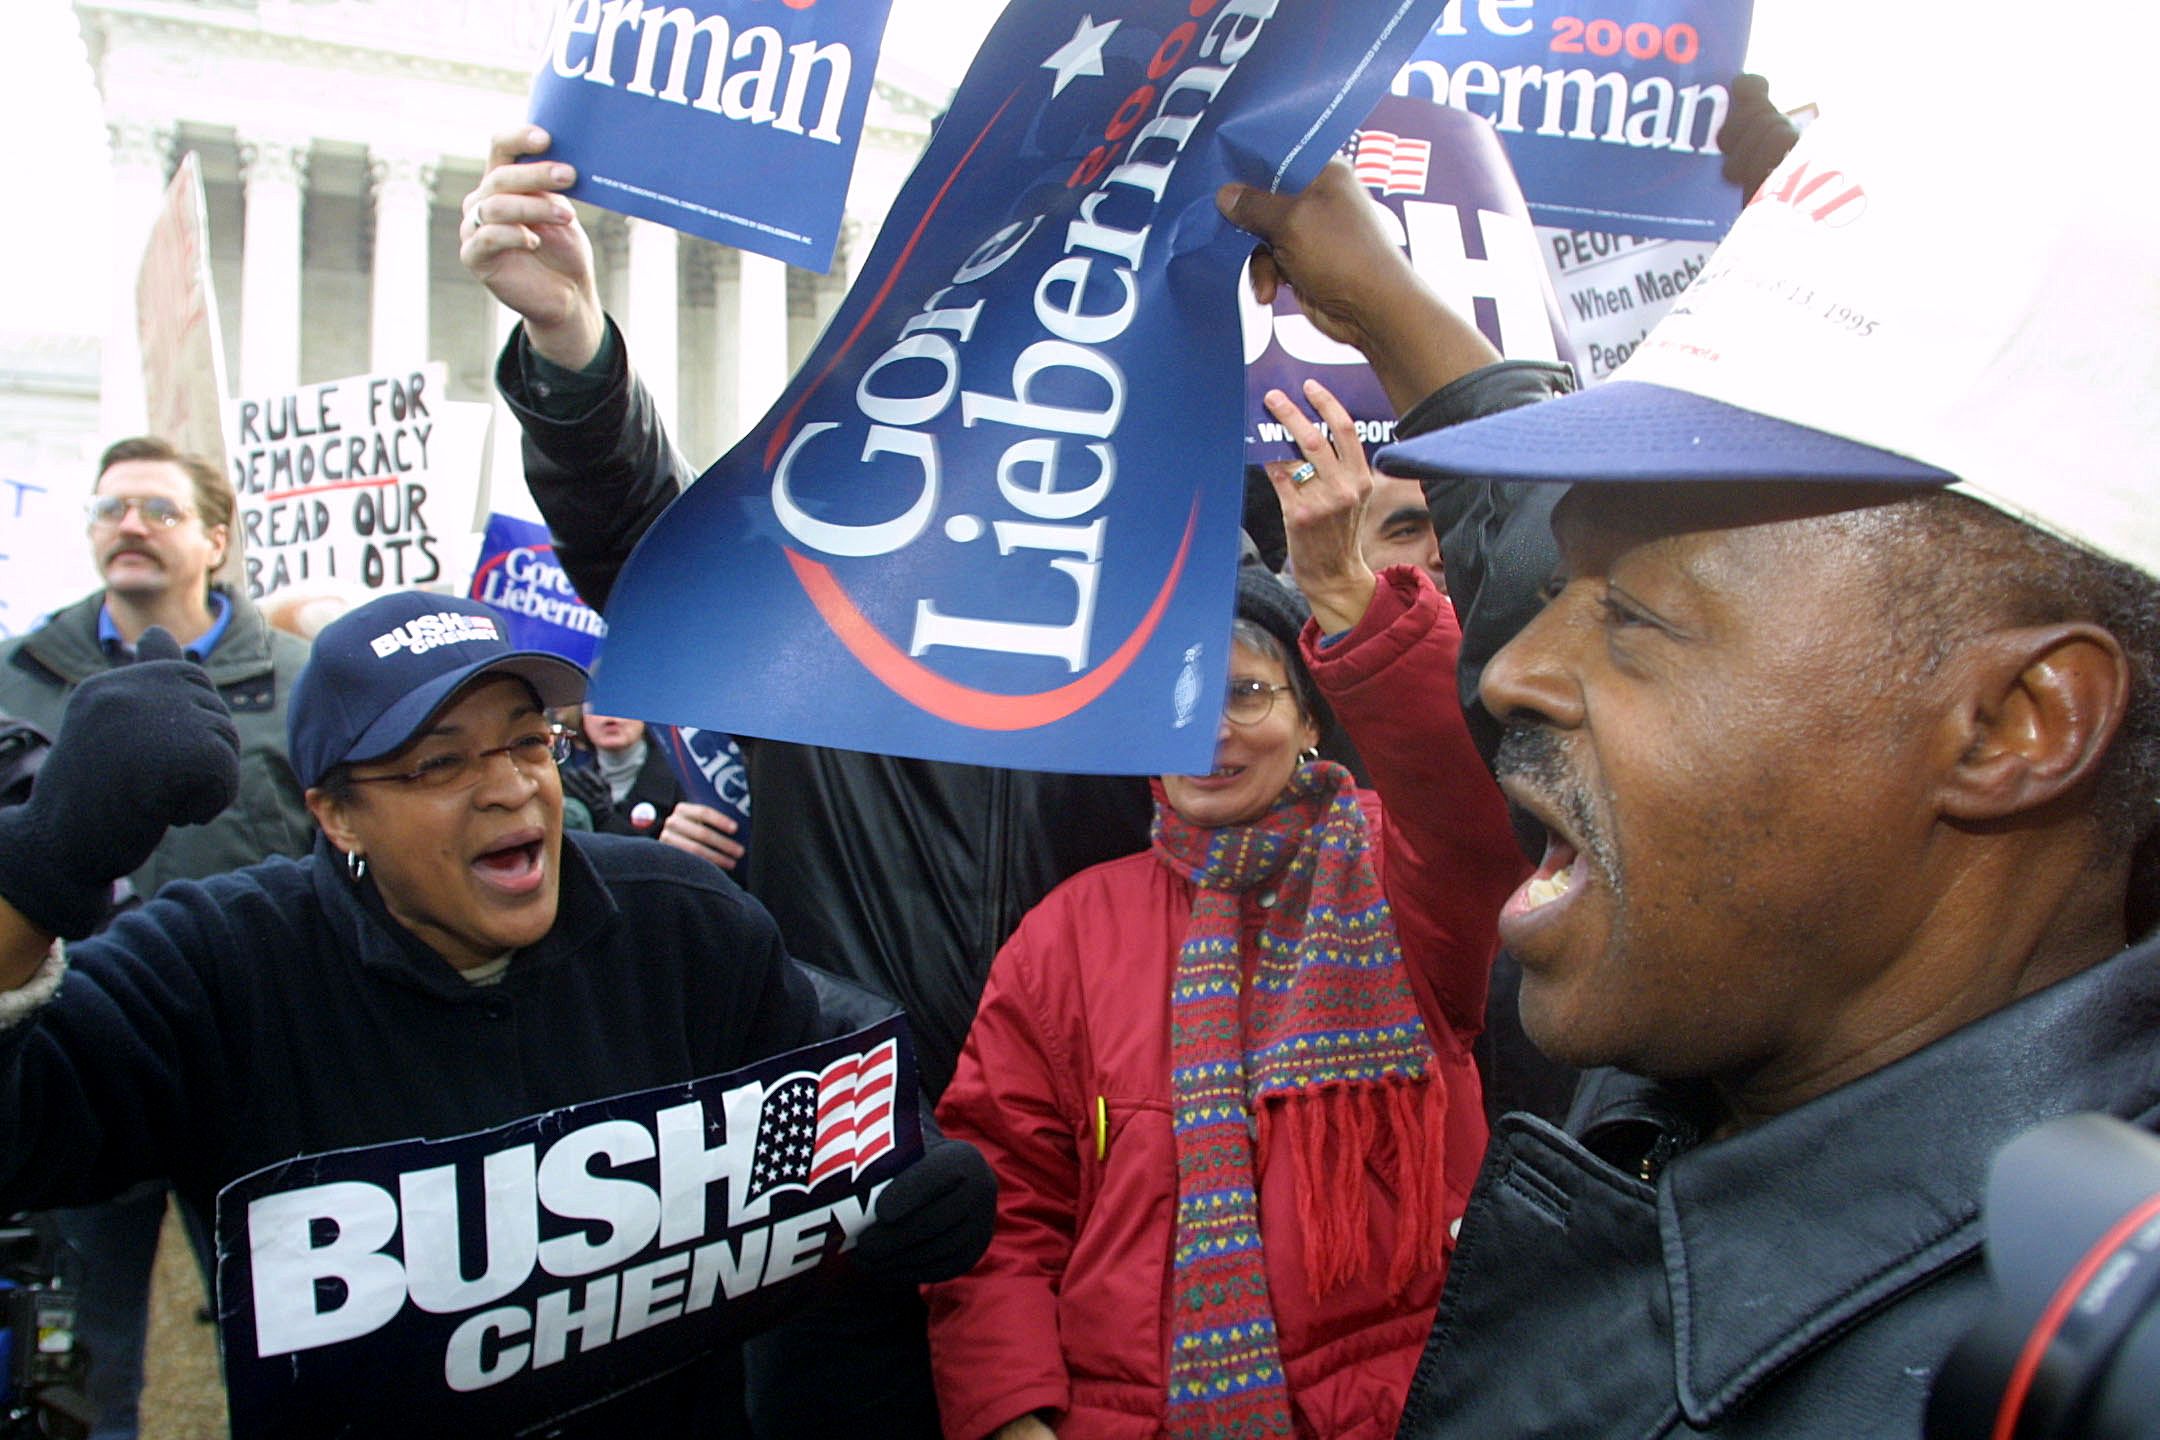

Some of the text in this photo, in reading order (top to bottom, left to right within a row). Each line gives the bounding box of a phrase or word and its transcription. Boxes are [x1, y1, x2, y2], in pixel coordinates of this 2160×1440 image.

[1331, 93, 1344, 110] AND
[1373, 38, 1383, 53] BY
[1551, 16, 1699, 65] 2000
[1570, 284, 1634, 322] When
[1823, 303, 1881, 337] 1995
[240, 371, 430, 446] RULE FOR
[772, 213, 1046, 557] Gore
[243, 484, 429, 550] READ OUR
[370, 611, 465, 659] BUSH
[247, 1079, 772, 1359] BUSH
[444, 1178, 895, 1394] CHENEY
